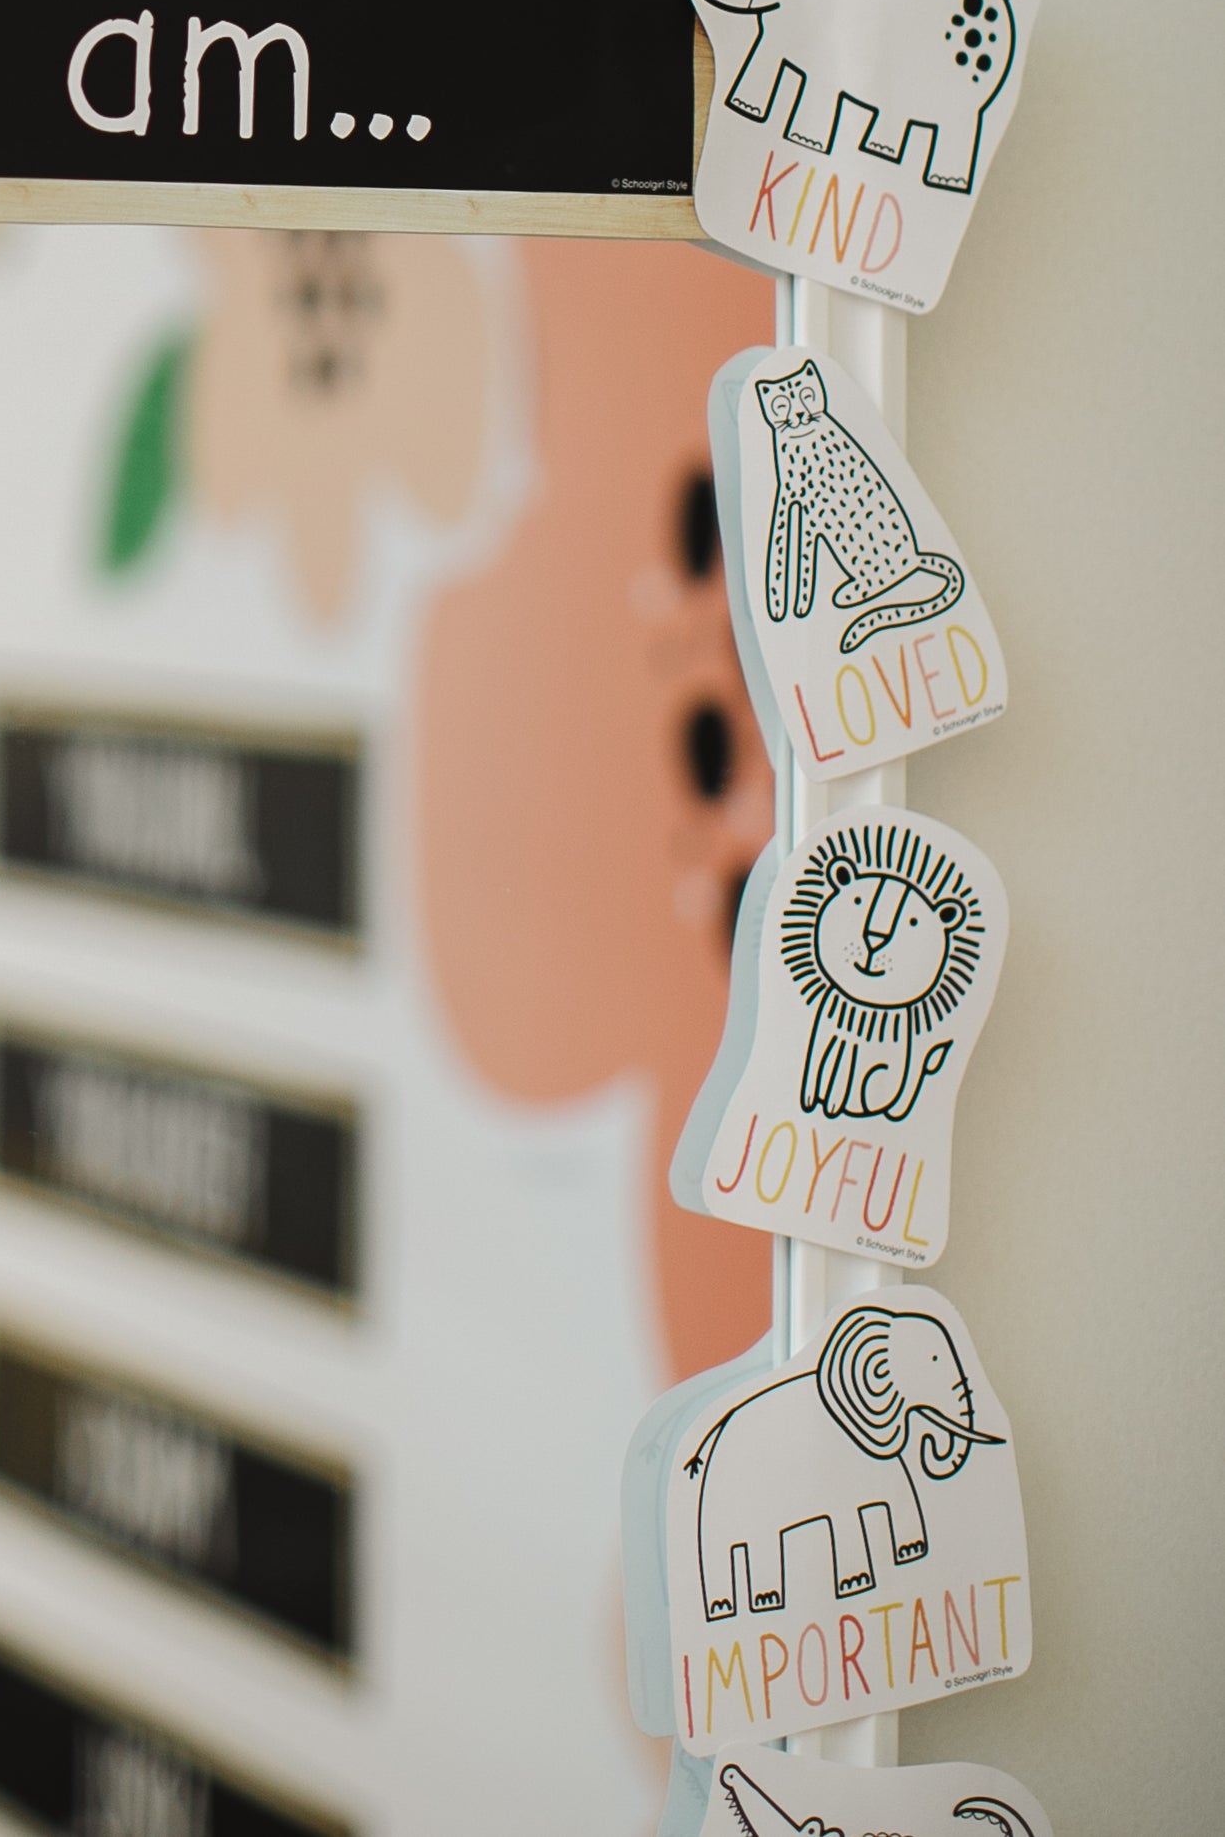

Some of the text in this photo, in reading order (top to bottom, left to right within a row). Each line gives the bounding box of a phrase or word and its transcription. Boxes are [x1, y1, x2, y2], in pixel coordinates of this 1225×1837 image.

[67, 10, 432, 141] am...
[621, 178, 665, 191] Schoolgirl
[666, 180, 688, 192] Style
[749, 150, 903, 273] KIND
[795, 625, 987, 762] LOVED
[716, 1114, 929, 1247] JOYFUL
[683, 1576, 1021, 1738] IMPORTANT
